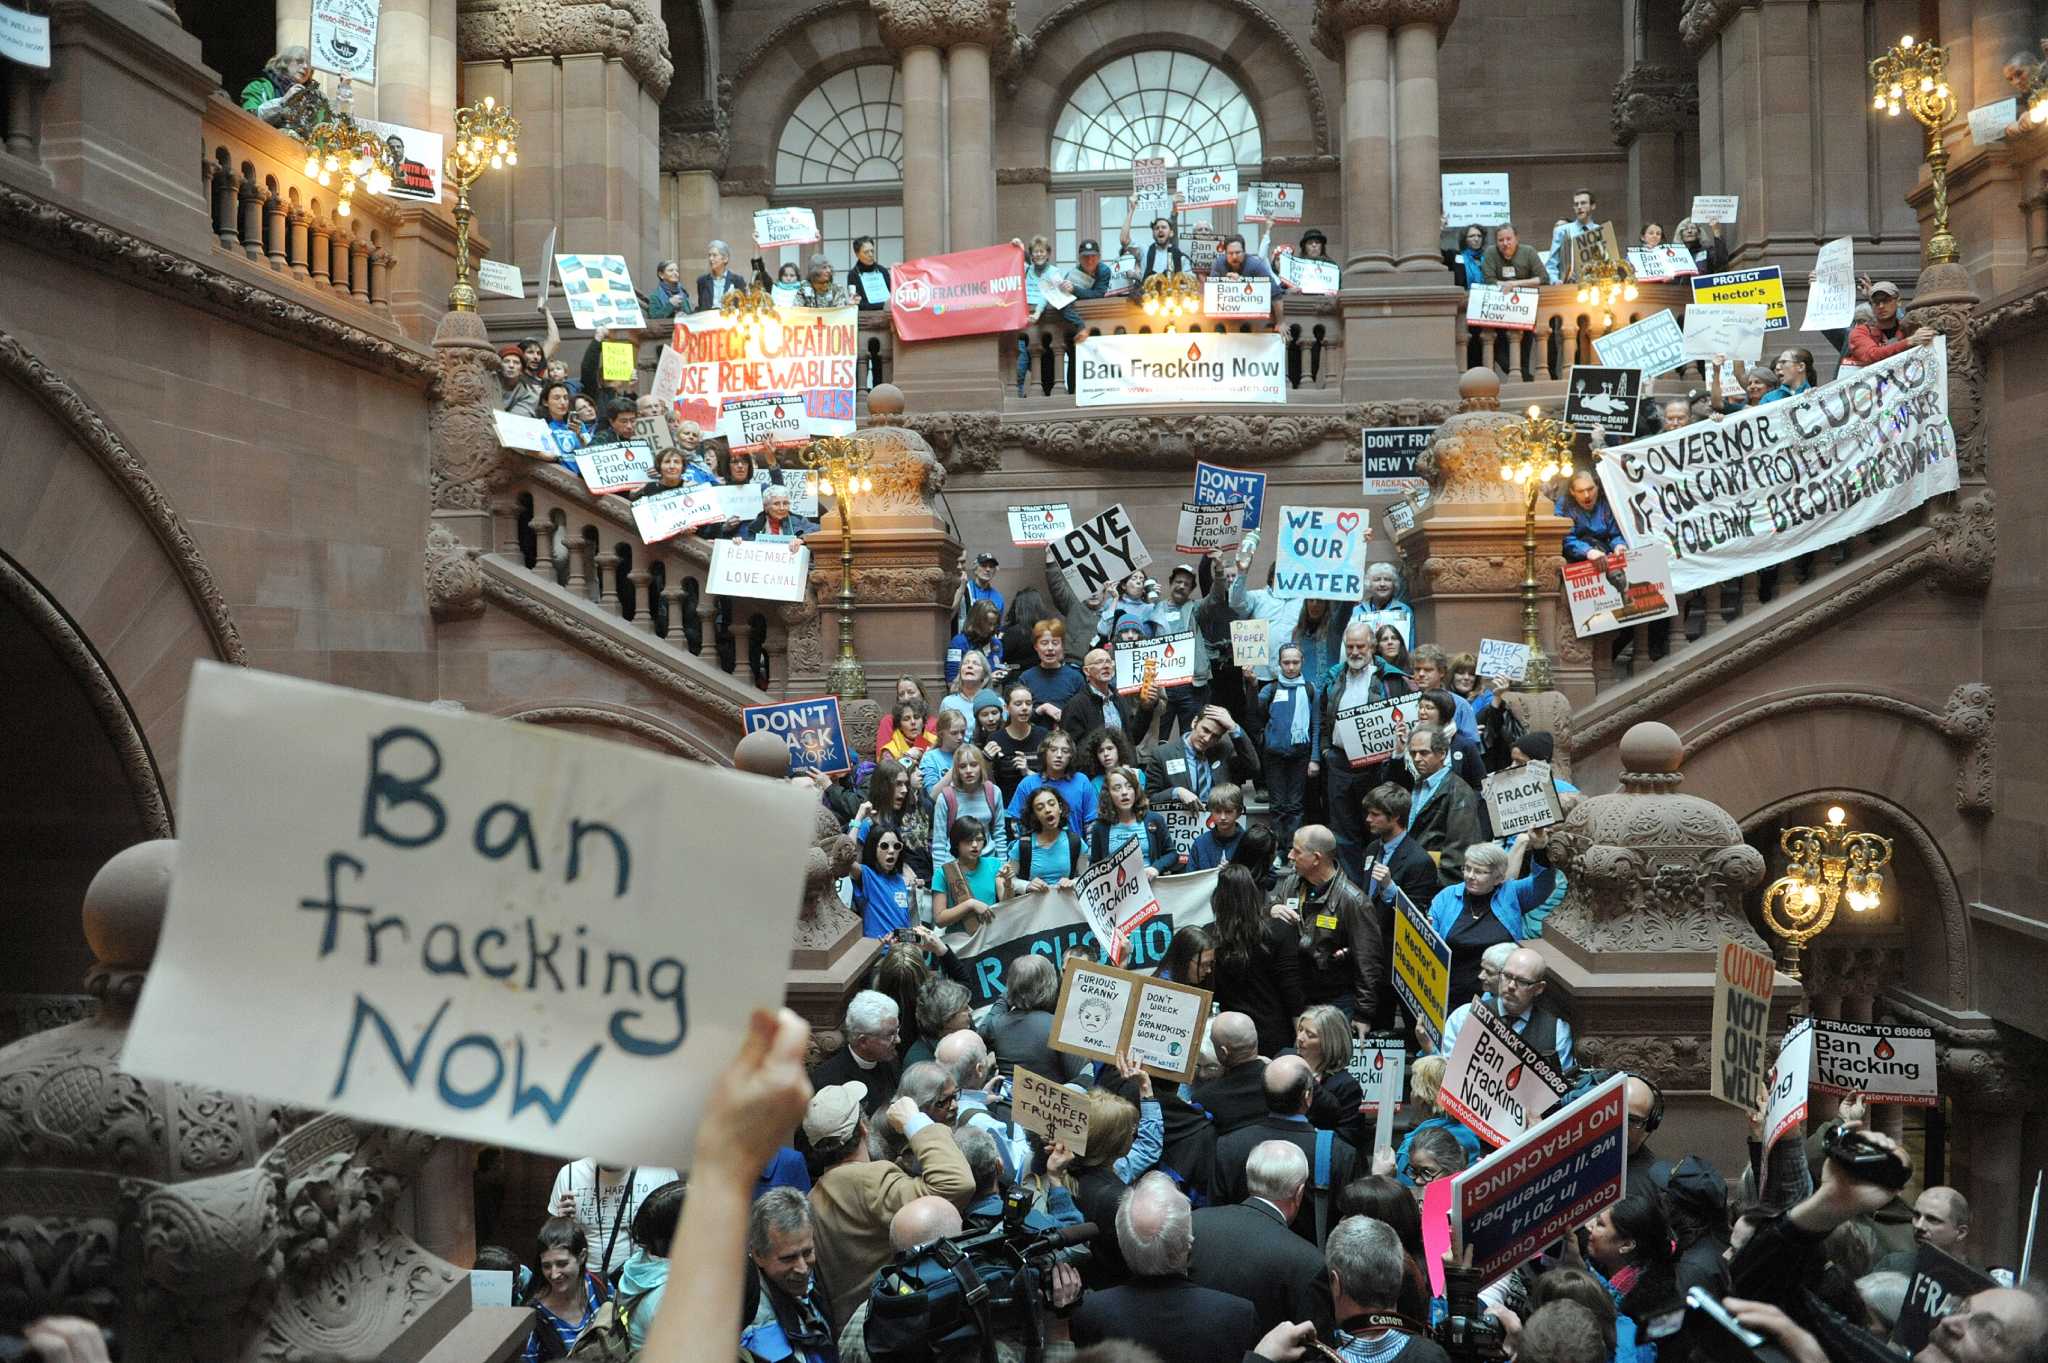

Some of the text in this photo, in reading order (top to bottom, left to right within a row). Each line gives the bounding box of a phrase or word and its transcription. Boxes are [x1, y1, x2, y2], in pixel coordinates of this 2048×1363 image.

[1137, 184, 1166, 192] FOR
[1188, 176, 1207, 185] Ban
[1188, 183, 1231, 194] Fracking
[1188, 193, 1209, 203] Now
[1257, 189, 1273, 198] Ban
[1257, 198, 1296, 209] Fracking
[1713, 271, 1760, 286] PROTECT
[899, 276, 1021, 303] STOP FRACKING NOW!
[1217, 284, 1239, 293] Ban
[1712, 287, 1766, 302] Hector's
[1217, 293, 1264, 303] Fracking
[1217, 302, 1241, 312] Now
[1481, 302, 1529, 315] Fracking
[1480, 311, 1505, 321] Now
[1622, 323, 1681, 359] PIPELINE
[717, 360, 854, 393] RENEWABLES
[1083, 356, 1280, 382] Ban Fracking Now
[740, 408, 768, 422] Ban
[1571, 413, 1629, 424] FRACKING DEATH
[1621, 416, 1779, 483] GOVERNOR
[1789, 356, 1926, 440] CUOMO
[741, 417, 800, 434] Fracking
[744, 431, 774, 444] Now
[1367, 434, 1405, 449] DON'T
[592, 453, 619, 466] Ban
[595, 459, 649, 476] Fracking
[1367, 457, 1401, 472] NEW
[600, 472, 629, 486] Now
[1200, 469, 1258, 493] DON'T
[1629, 491, 1654, 535] IF
[1652, 478, 1699, 522] YOU
[1664, 520, 1713, 560] YOU
[1767, 467, 1862, 533] BECOME
[1020, 513, 1040, 522] Ban
[1021, 520, 1065, 531] Fracking
[1195, 514, 1219, 526] Ban
[1286, 511, 1323, 530] WE
[1024, 531, 1046, 540] Now
[1049, 506, 1131, 570] LOVE
[1193, 525, 1238, 537] Fracking
[1192, 536, 1219, 547] Now
[1293, 537, 1343, 559] OUR
[727, 547, 796, 564] REMEMBER
[1076, 536, 1137, 594] NY
[726, 570, 797, 586] LOVE CANAL
[1276, 572, 1361, 594] WATER
[1572, 585, 1606, 602] FRACK
[1135, 637, 1163, 648] "FRACK"
[1233, 633, 1266, 643] PROPER
[1132, 650, 1158, 662] Ban
[1336, 697, 1401, 720] TEXT "FRACK" TO
[752, 704, 829, 732] DON'T
[1355, 714, 1385, 730] Ban
[1361, 738, 1395, 755] Now
[795, 747, 838, 765] YORK
[1497, 780, 1544, 805] FRACK
[362, 726, 631, 897] Ban
[1152, 803, 1170, 811] TEXT
[1166, 812, 1198, 827] Ban
[1501, 808, 1553, 831] WATER=LIFE
[1114, 852, 1124, 865] TO
[1086, 880, 1111, 908] Ban
[1407, 906, 1437, 951] PROTECT
[299, 850, 689, 1057] fracking
[1394, 941, 1415, 980] Clean
[1404, 928, 1437, 981] Hector's
[1723, 943, 1776, 999] CUOMO
[1077, 973, 1117, 991] FURIOUS
[1395, 973, 1405, 995] NO
[1080, 984, 1119, 1001] GRANNY
[1146, 992, 1174, 1004] DON'T
[1140, 1011, 1154, 1020] MY
[1149, 1003, 1179, 1016] WRECK
[1726, 988, 1767, 1036] NOT
[1137, 1029, 1167, 1042] WORLD
[1820, 1020, 1932, 1038] "FRACK" TO 69866
[1083, 1035, 1111, 1049] SAYS...
[1375, 1039, 1385, 1048] TO
[1473, 1001, 1568, 1094] TEXT "FRACK" TO 69866
[1815, 1033, 1861, 1055] Ban
[1473, 1030, 1505, 1074] Ban
[1724, 1027, 1762, 1075] ONE
[1817, 1050, 1920, 1080] Fracking
[1818, 1067, 1869, 1091] Now
[1023, 1077, 1071, 1107] SAFE
[1459, 1076, 1493, 1121] Now
[1465, 1056, 1525, 1127] Fracking
[1020, 1100, 1084, 1135] TRUMPS
[1038, 1095, 1088, 1127] WATER
[1466, 1100, 1619, 1207] NO FRACKING!
[1470, 1135, 1616, 1233] we'll remember.
[1511, 1195, 1555, 1235] 2014
[1540, 1183, 1617, 1241] Governor
[1369, 1314, 1403, 1327] Canon
